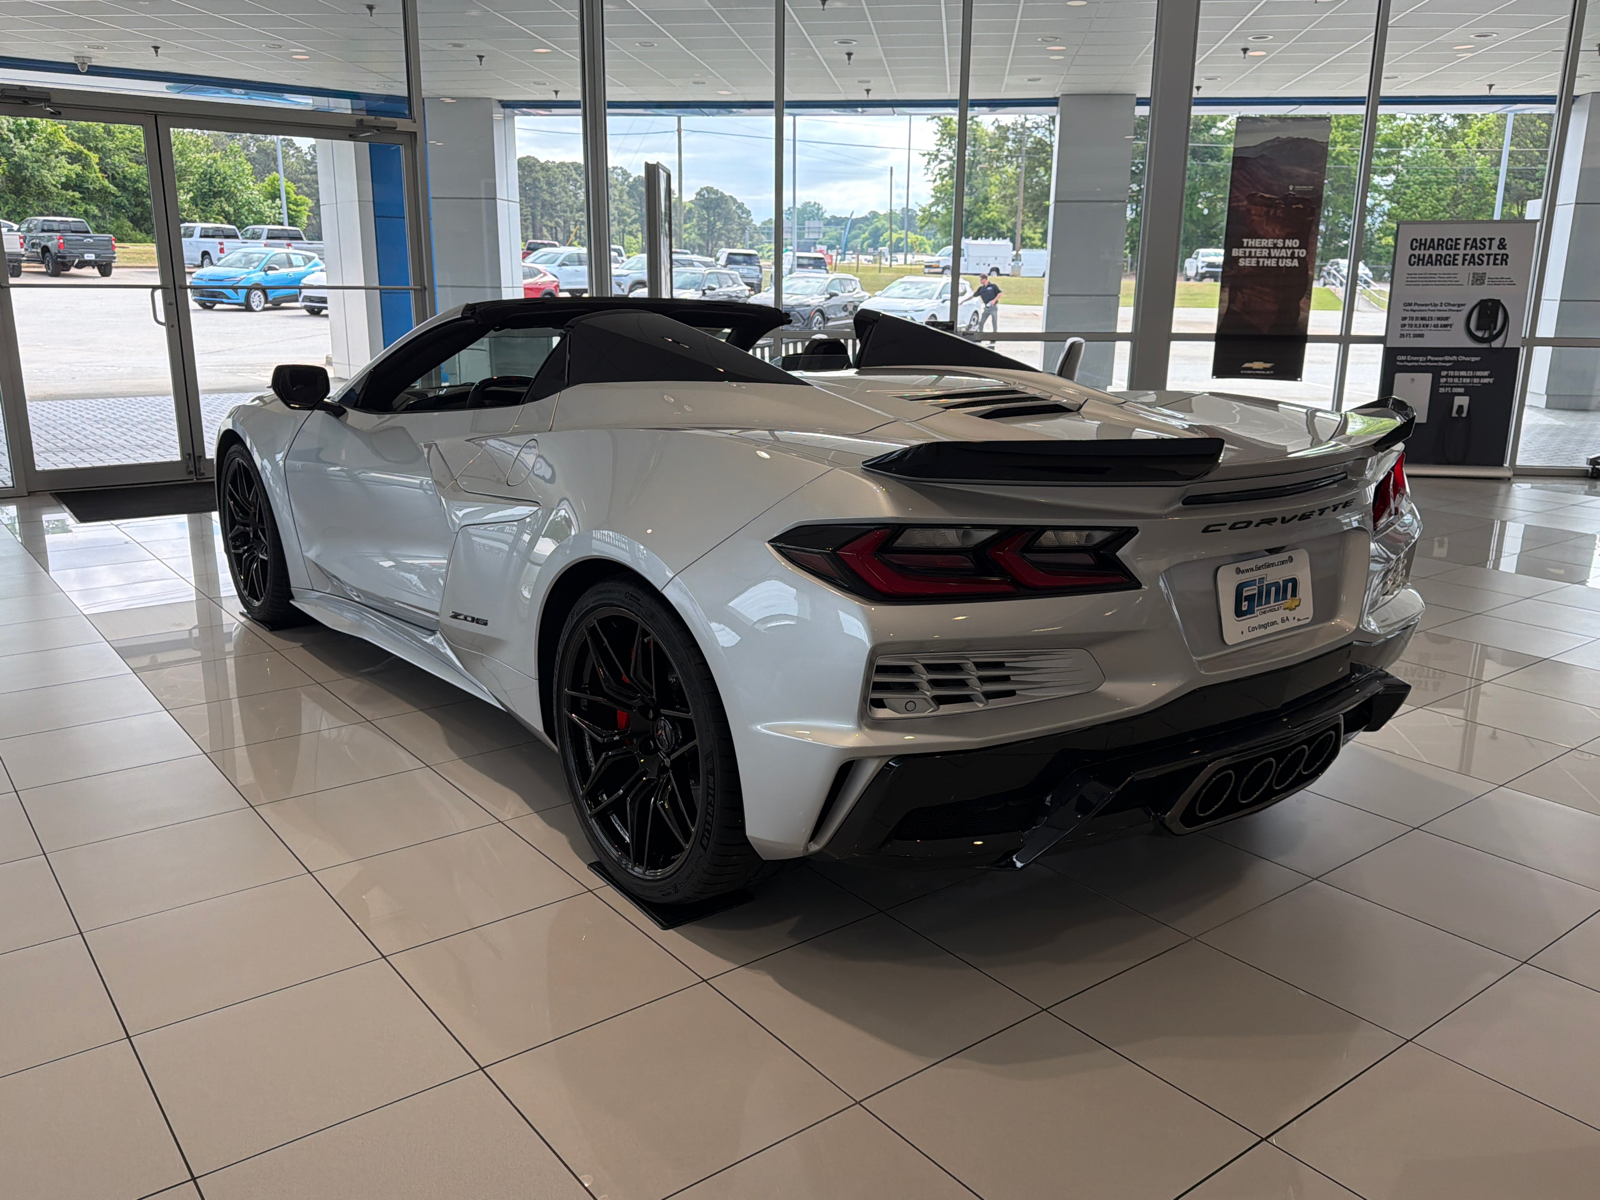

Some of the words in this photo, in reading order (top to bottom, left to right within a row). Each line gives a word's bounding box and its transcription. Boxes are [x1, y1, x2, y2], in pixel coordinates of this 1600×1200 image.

[1242, 238, 1284, 247] THERE'S
[1285, 239, 1300, 247] NO
[1409, 237, 1462, 251] CHARGE
[1463, 237, 1496, 251] FAST
[1497, 237, 1508, 251] &
[1231, 248, 1269, 257] BETTER
[1270, 249, 1294, 257] WAY
[1294, 249, 1307, 258] TO
[1408, 253, 1460, 267] CHARGE
[1461, 253, 1510, 267] FASTER
[1238, 258, 1258, 267] SEE
[1258, 258, 1278, 267] THE
[1278, 258, 1299, 267] USA
[1201, 498, 1355, 533] CORVETTE
[1240, 558, 1289, 574] www.GetGinn.com
[1234, 576, 1298, 619] Ginn
[449, 610, 489, 626] Z06
[1258, 606, 1283, 616] CHEVROLET
[1247, 619, 1279, 633] Covington,
[1280, 615, 1290, 625] GA
[700, 773, 716, 853] MICHELIN
